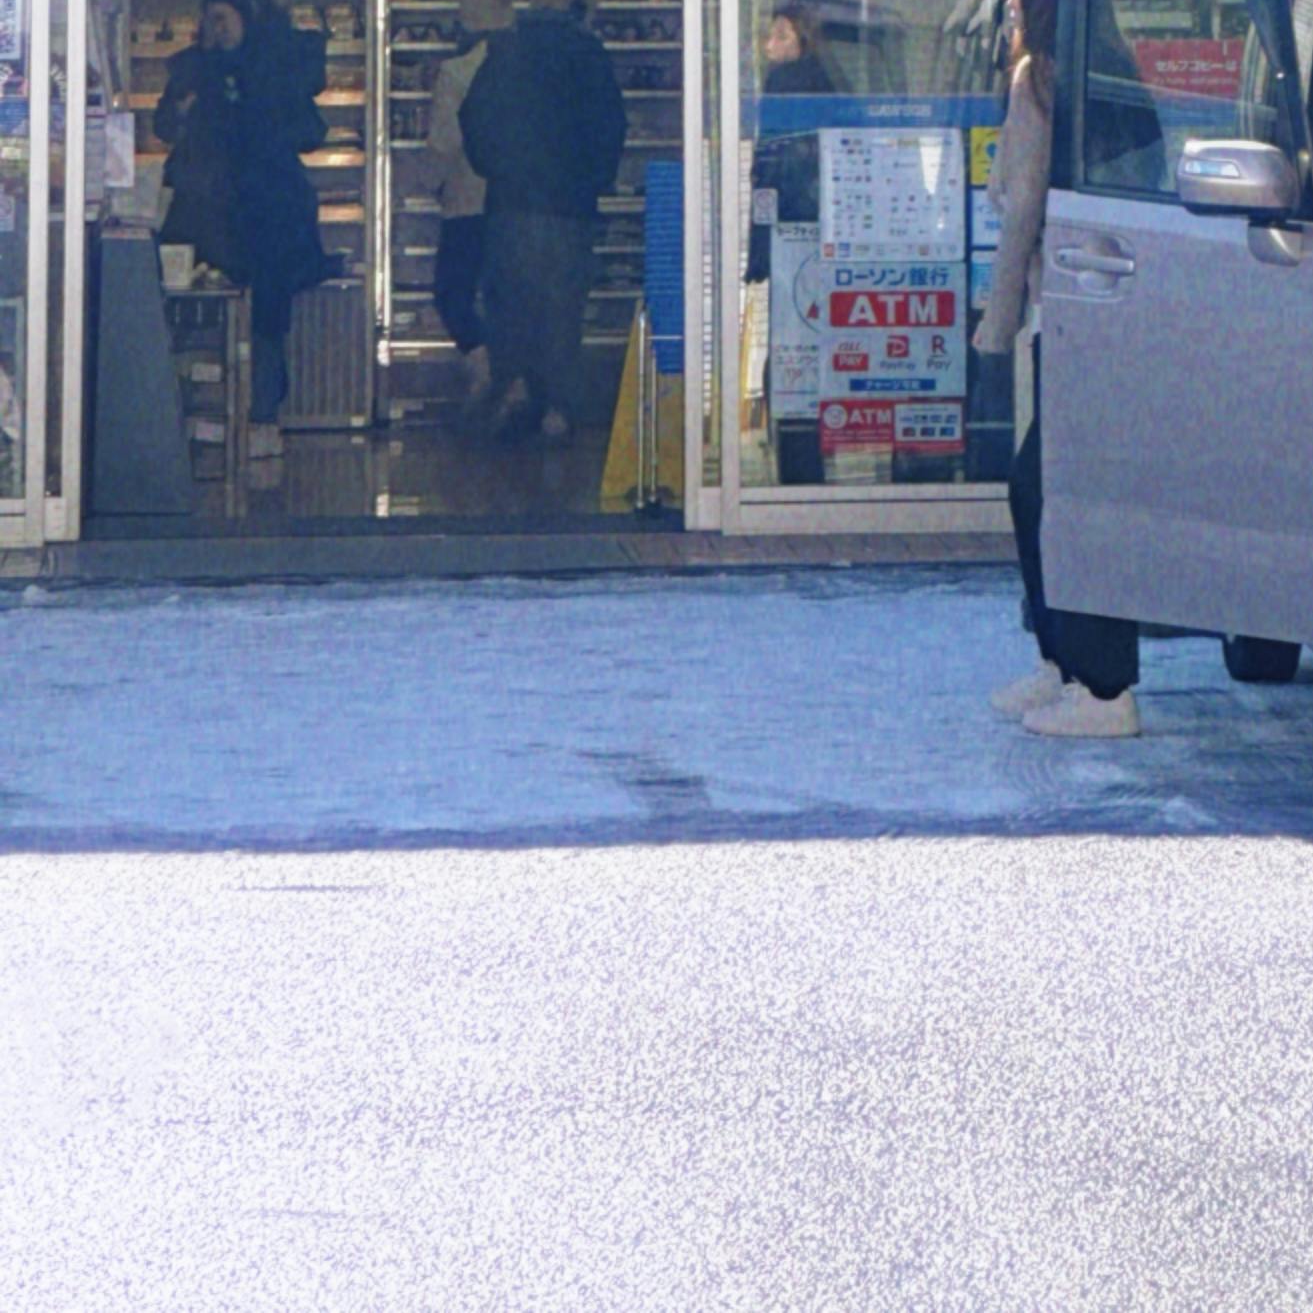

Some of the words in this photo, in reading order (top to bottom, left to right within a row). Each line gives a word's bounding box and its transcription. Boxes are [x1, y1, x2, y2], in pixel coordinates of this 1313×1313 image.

[834, 268, 950, 287] ローソン銀行
[848, 294, 939, 324] ATM
[849, 408, 891, 425] ATM
